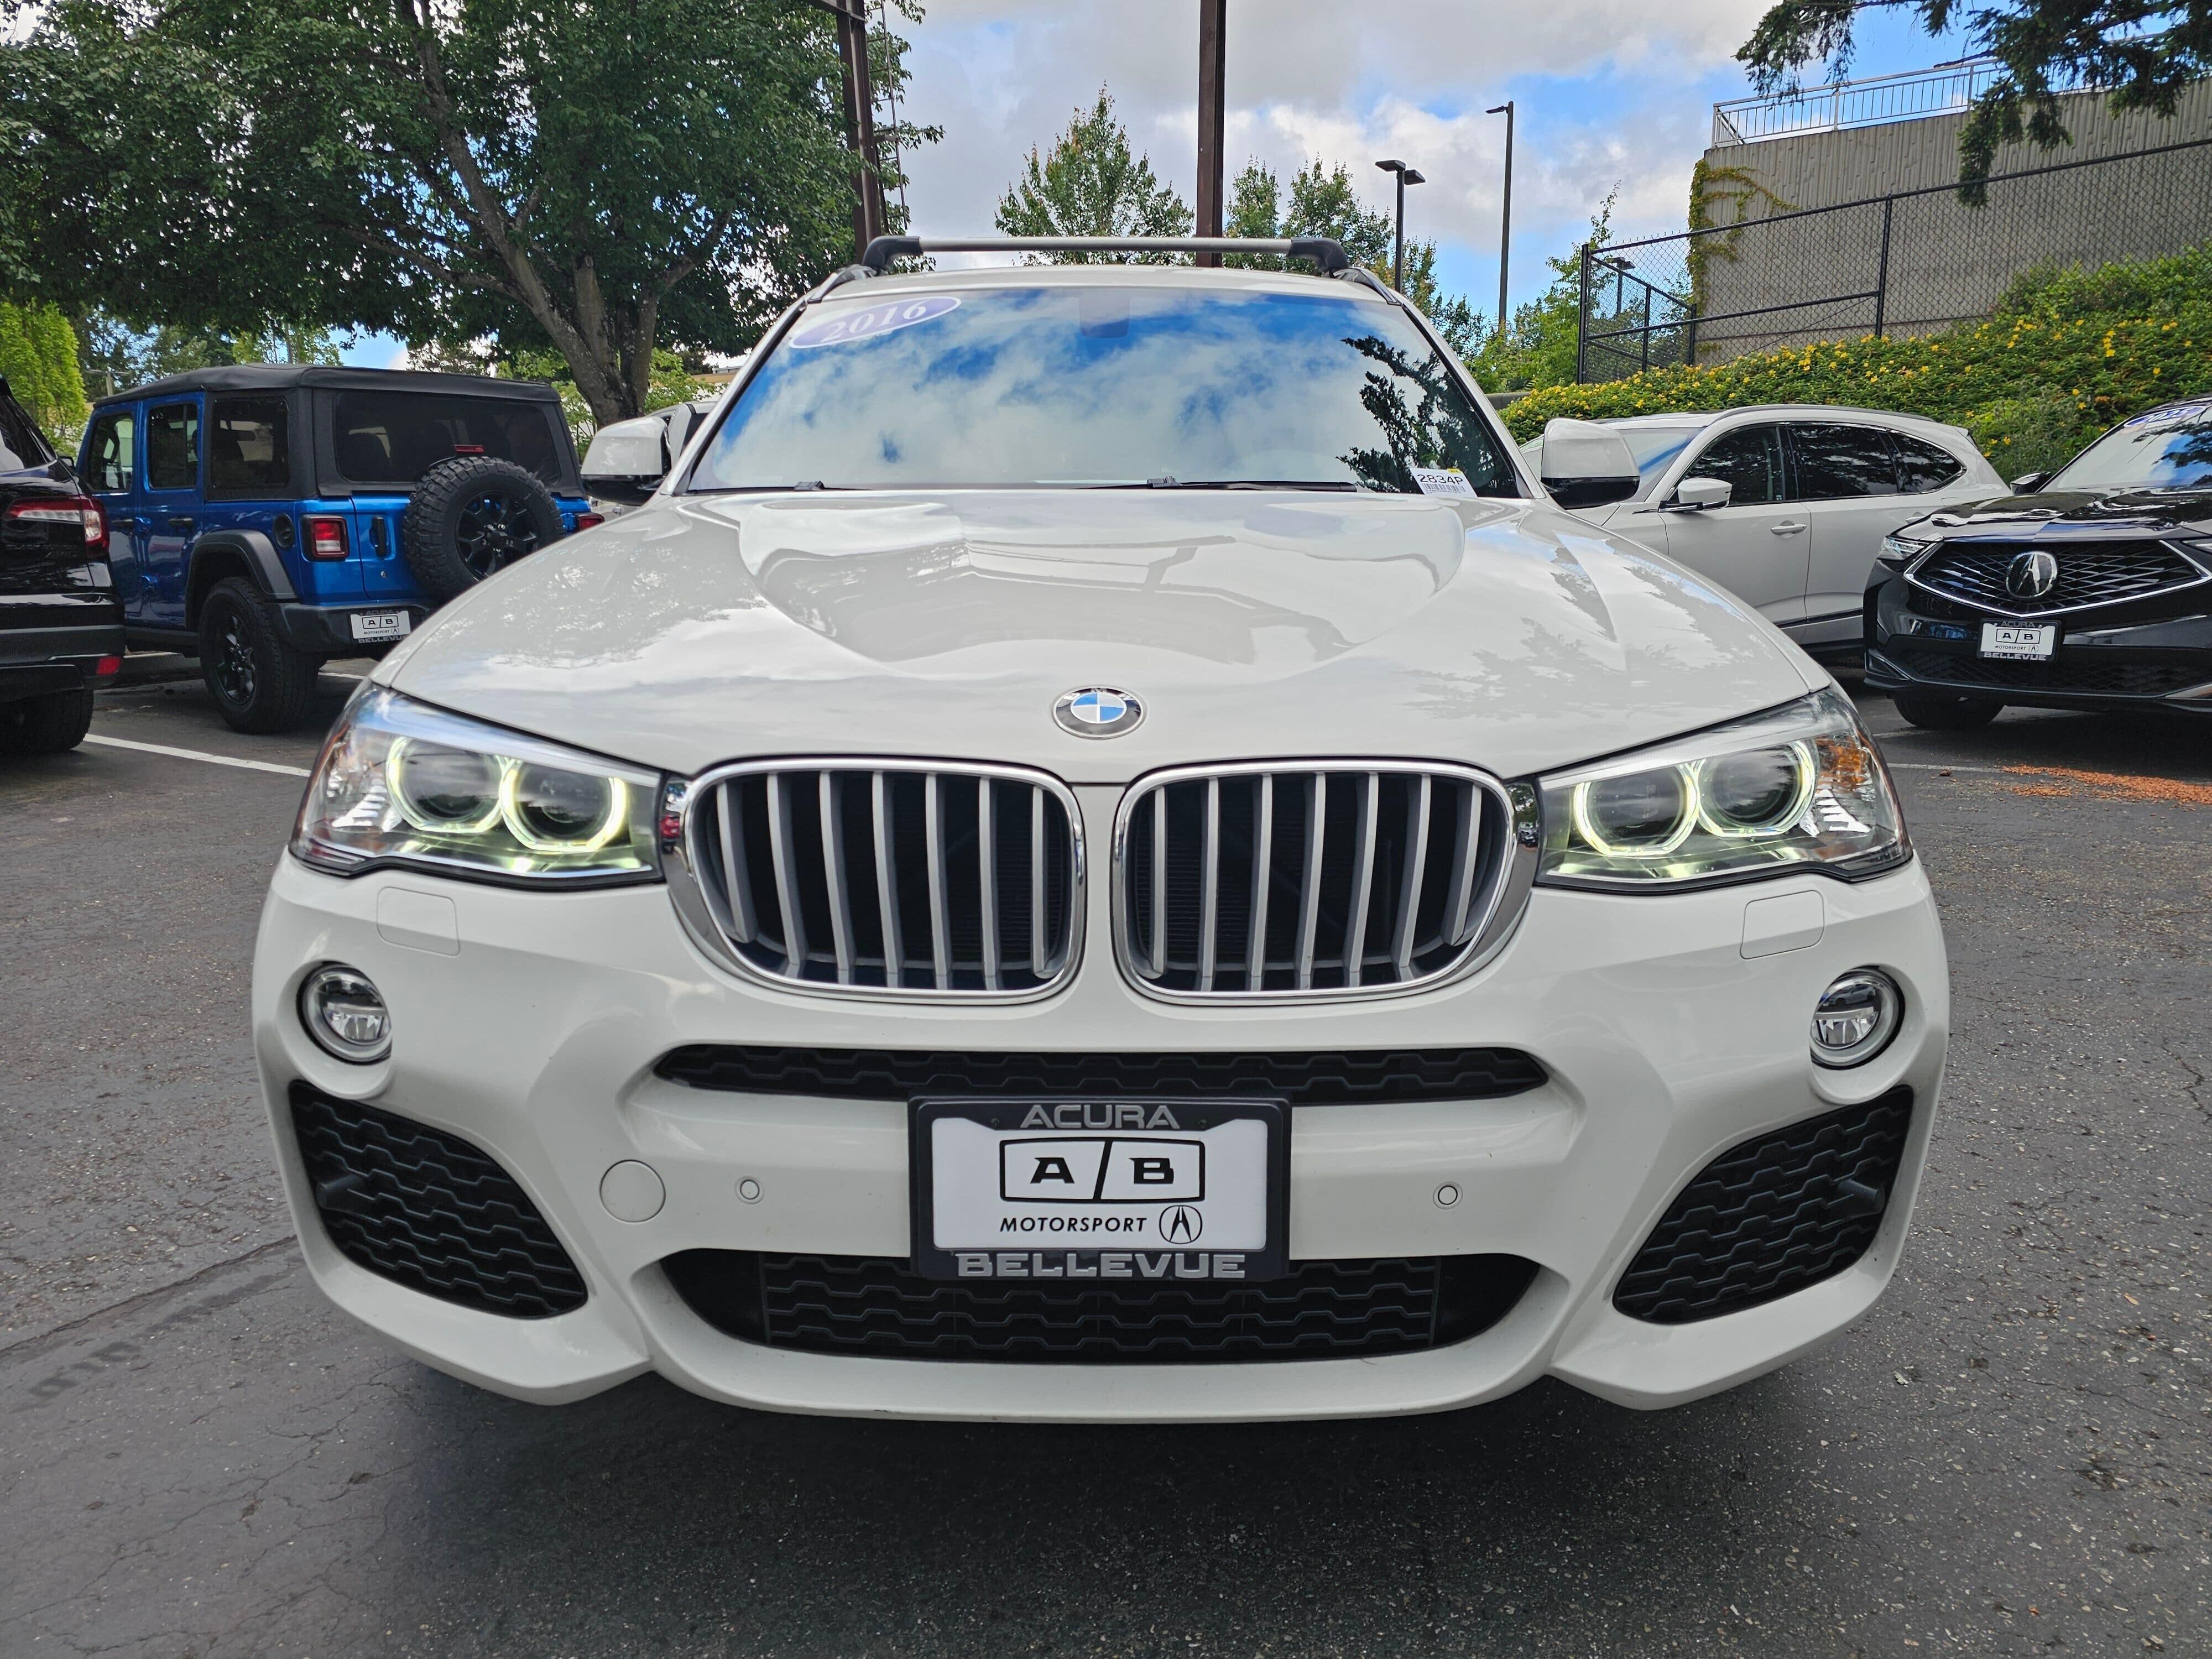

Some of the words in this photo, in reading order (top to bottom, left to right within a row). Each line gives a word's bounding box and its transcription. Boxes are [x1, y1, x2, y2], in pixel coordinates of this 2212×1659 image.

[820, 299, 931, 343] 2016
[1417, 474, 1463, 484] 2834P
[1983, 652, 2047, 661] BELLEVUE
[1020, 1104, 1180, 1129] ACURA
[999, 1217, 1147, 1233] MOTORSPORT
[954, 1253, 1245, 1279] BELLEVUE
